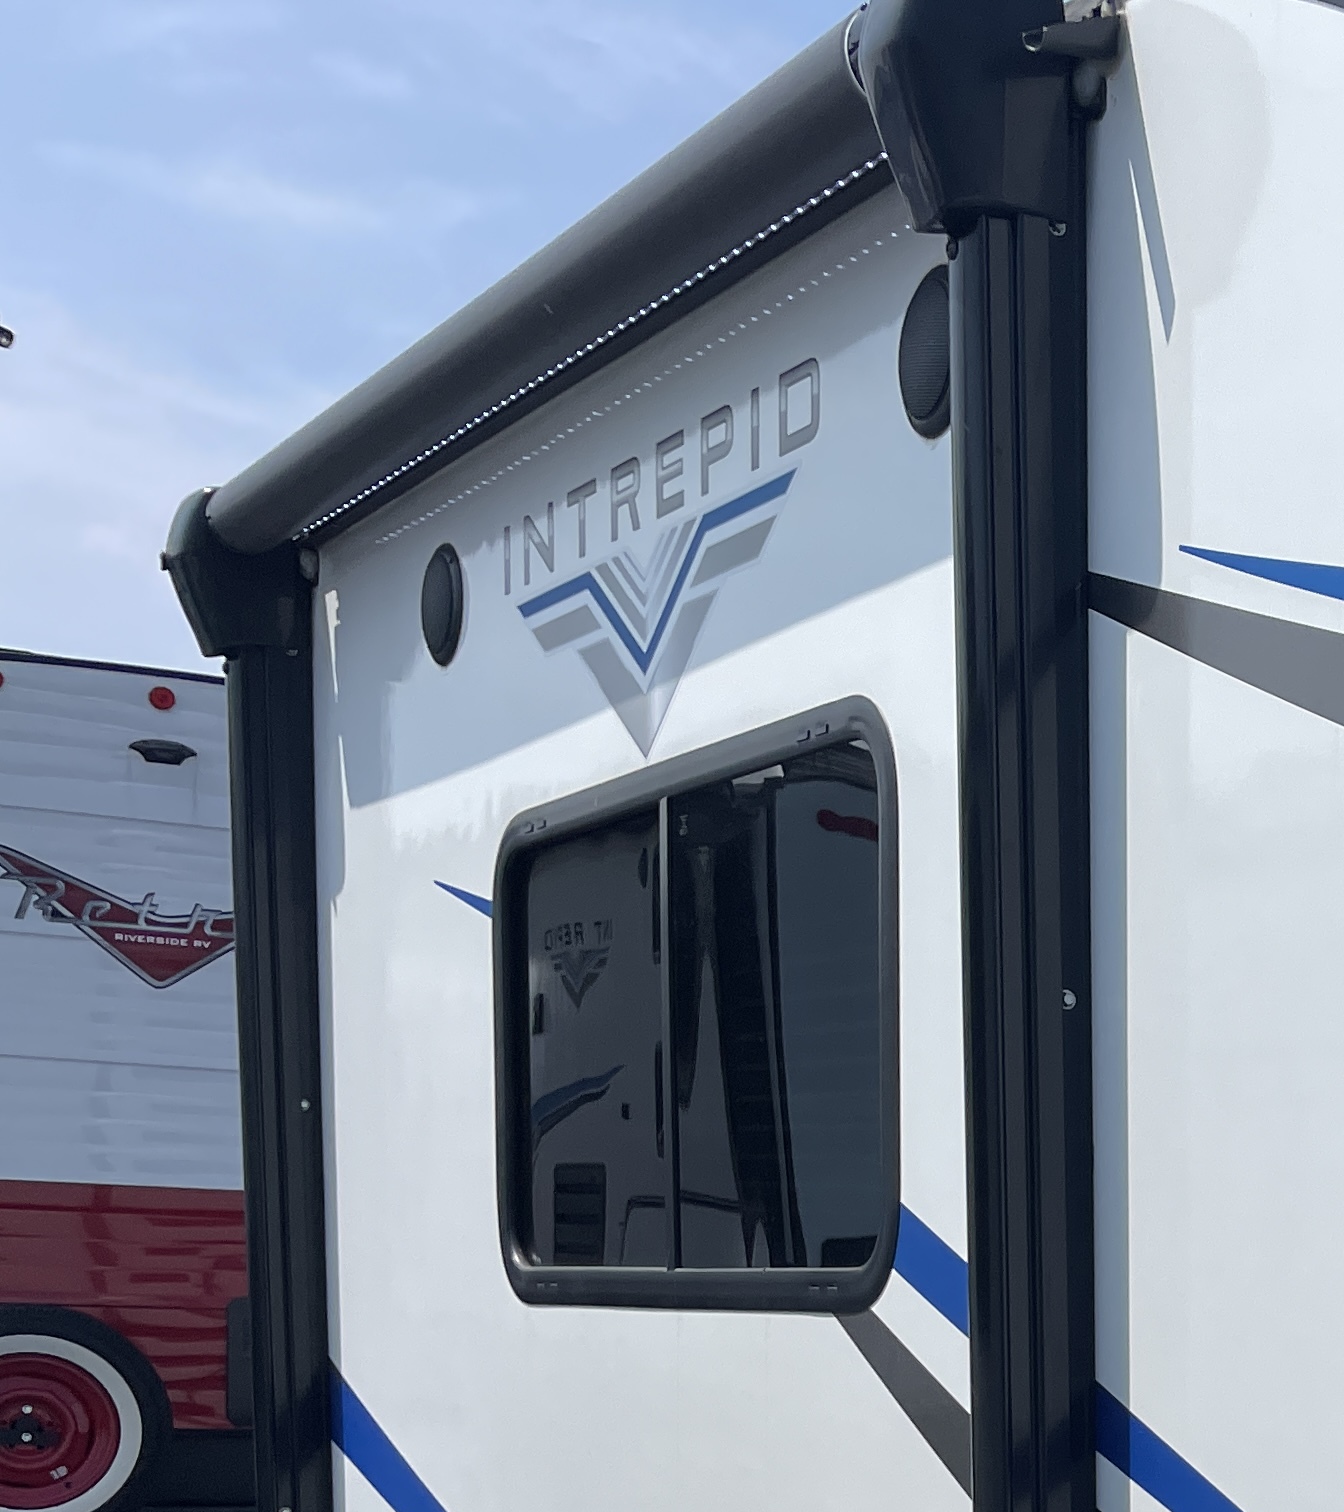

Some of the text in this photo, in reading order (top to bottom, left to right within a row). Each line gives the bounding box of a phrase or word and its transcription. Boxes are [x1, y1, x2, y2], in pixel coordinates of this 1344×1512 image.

[504, 357, 820, 596] INTREPID
[1, 872, 235, 939] Retr
[114, 932, 212, 950] RIVERSIDE RV
